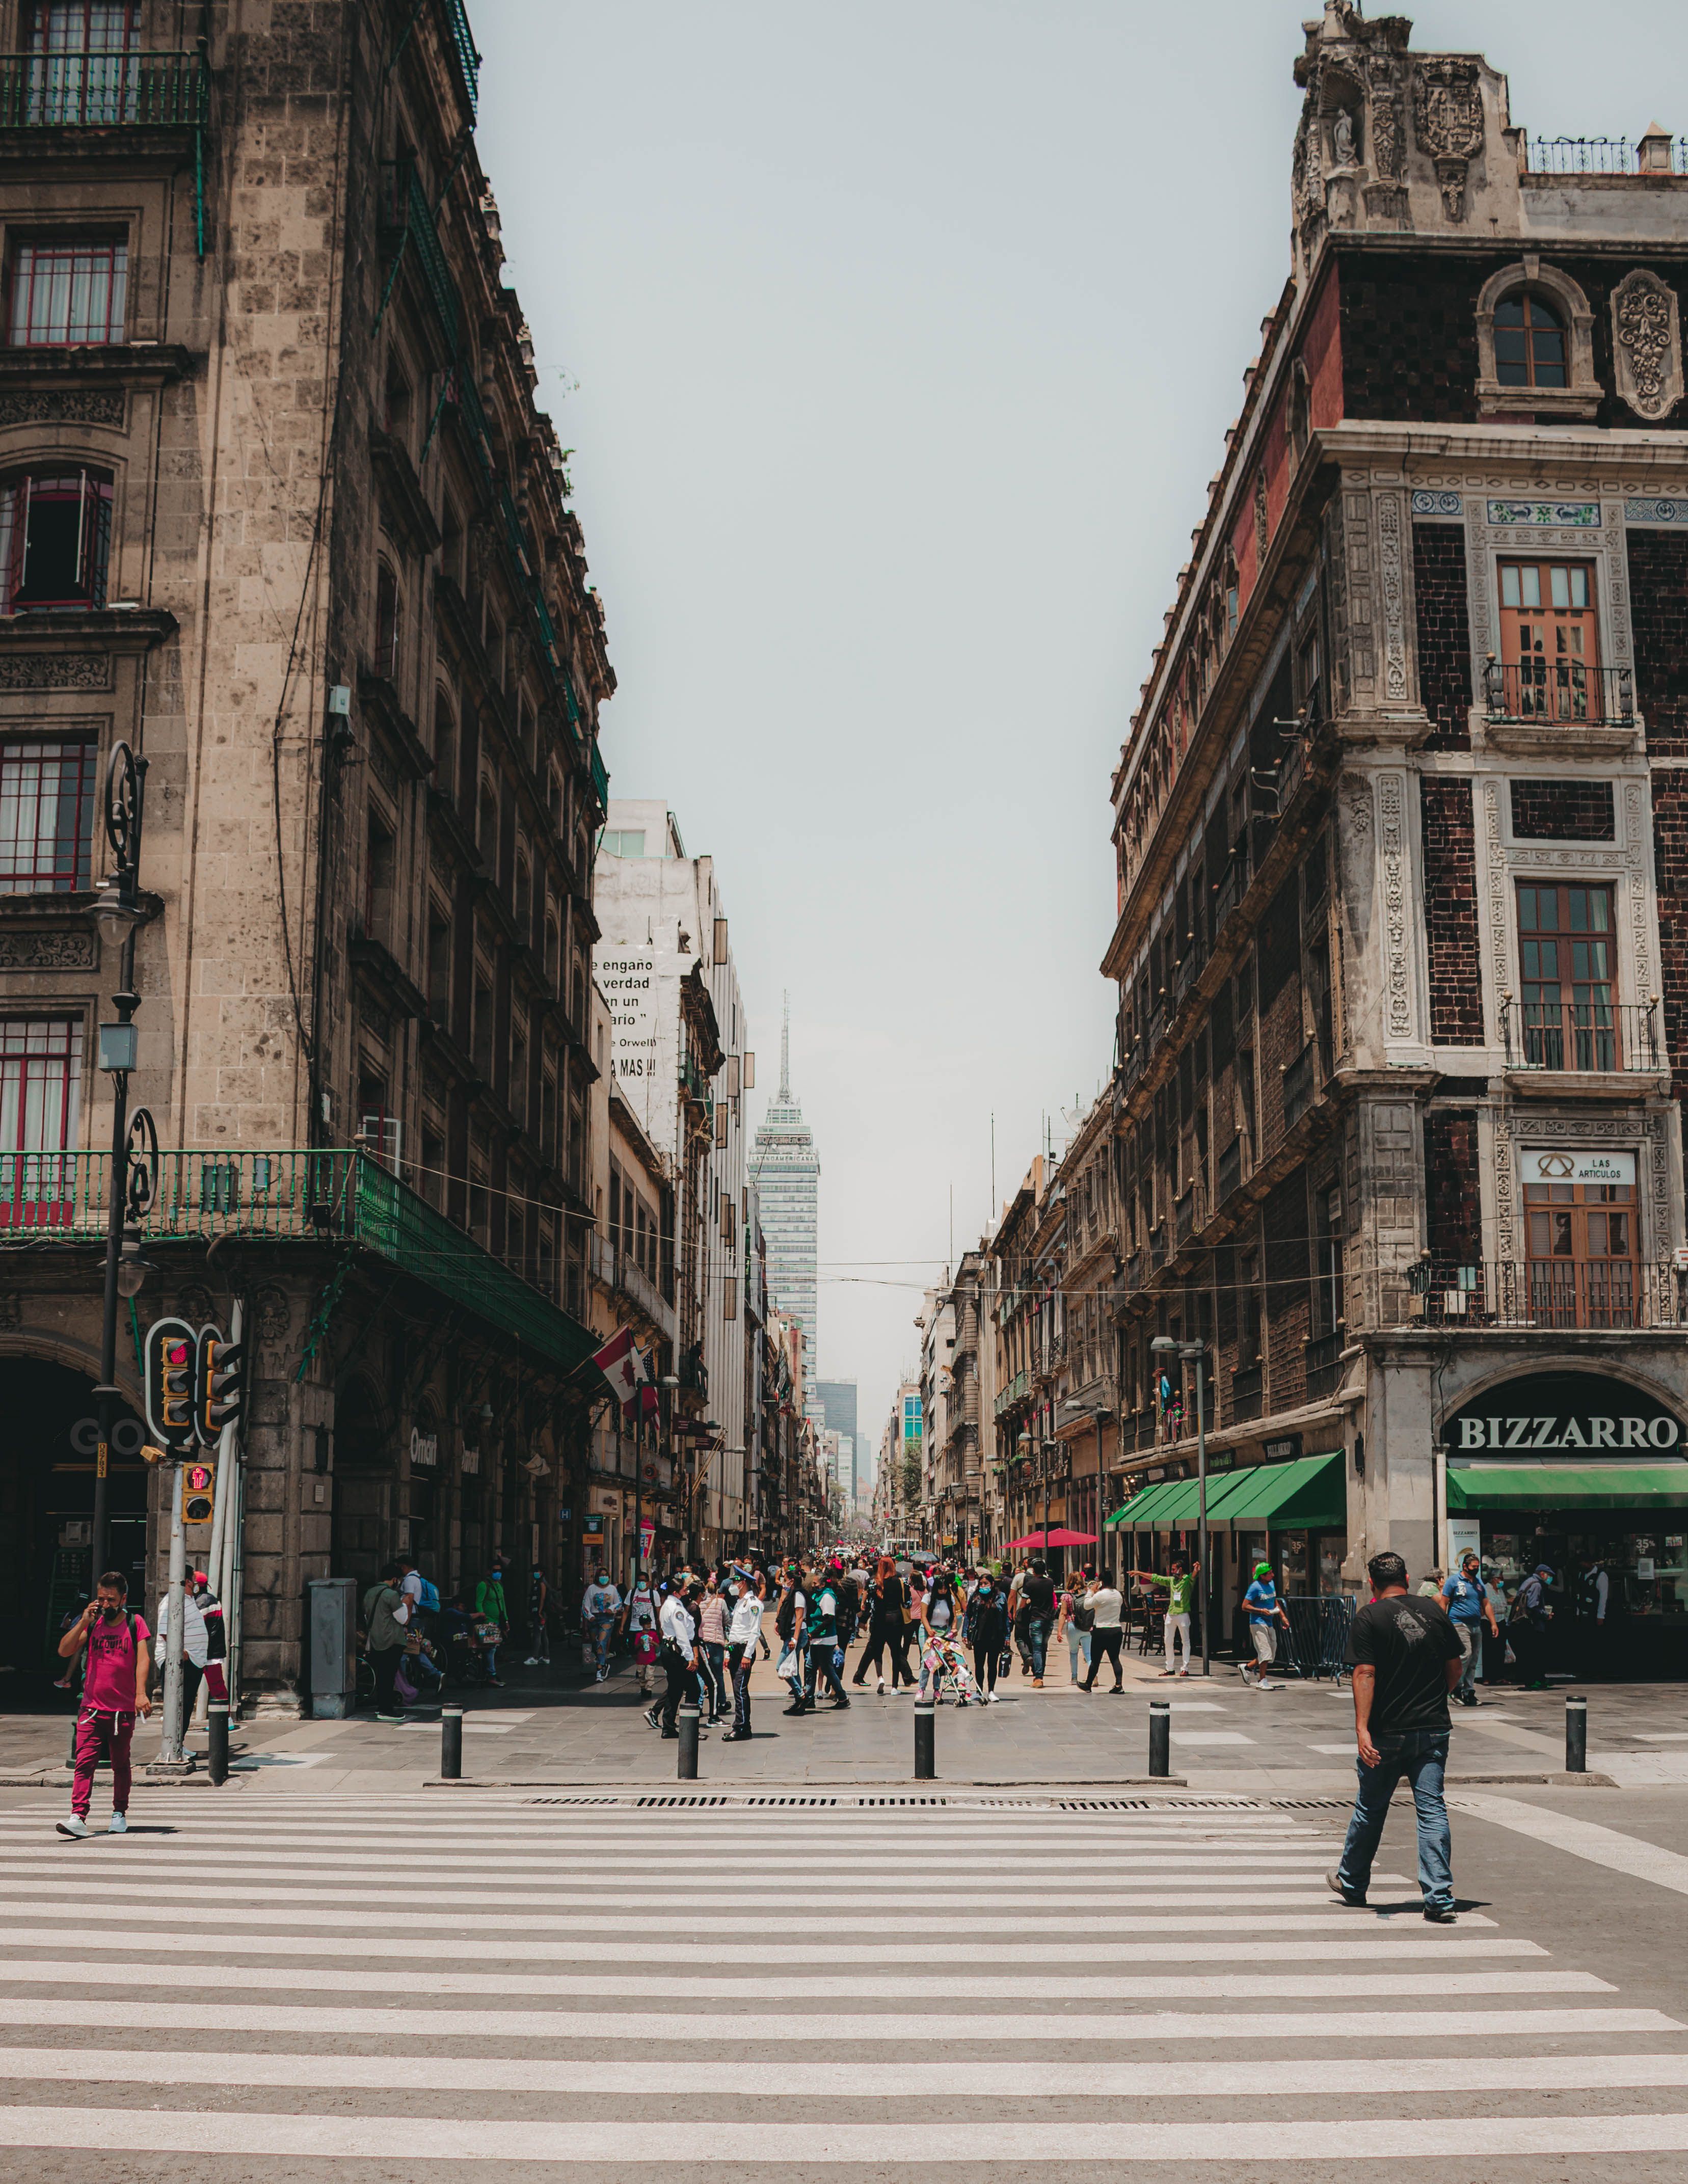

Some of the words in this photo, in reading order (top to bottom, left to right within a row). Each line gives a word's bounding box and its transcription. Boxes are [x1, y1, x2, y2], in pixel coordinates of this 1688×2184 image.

[603, 959, 653, 973] engaño
[603, 977, 649, 988] verdad
[623, 998, 638, 1006] un
[620, 1059, 642, 1076] MAS
[1458, 1417, 1678, 1448] BIZZARRO
